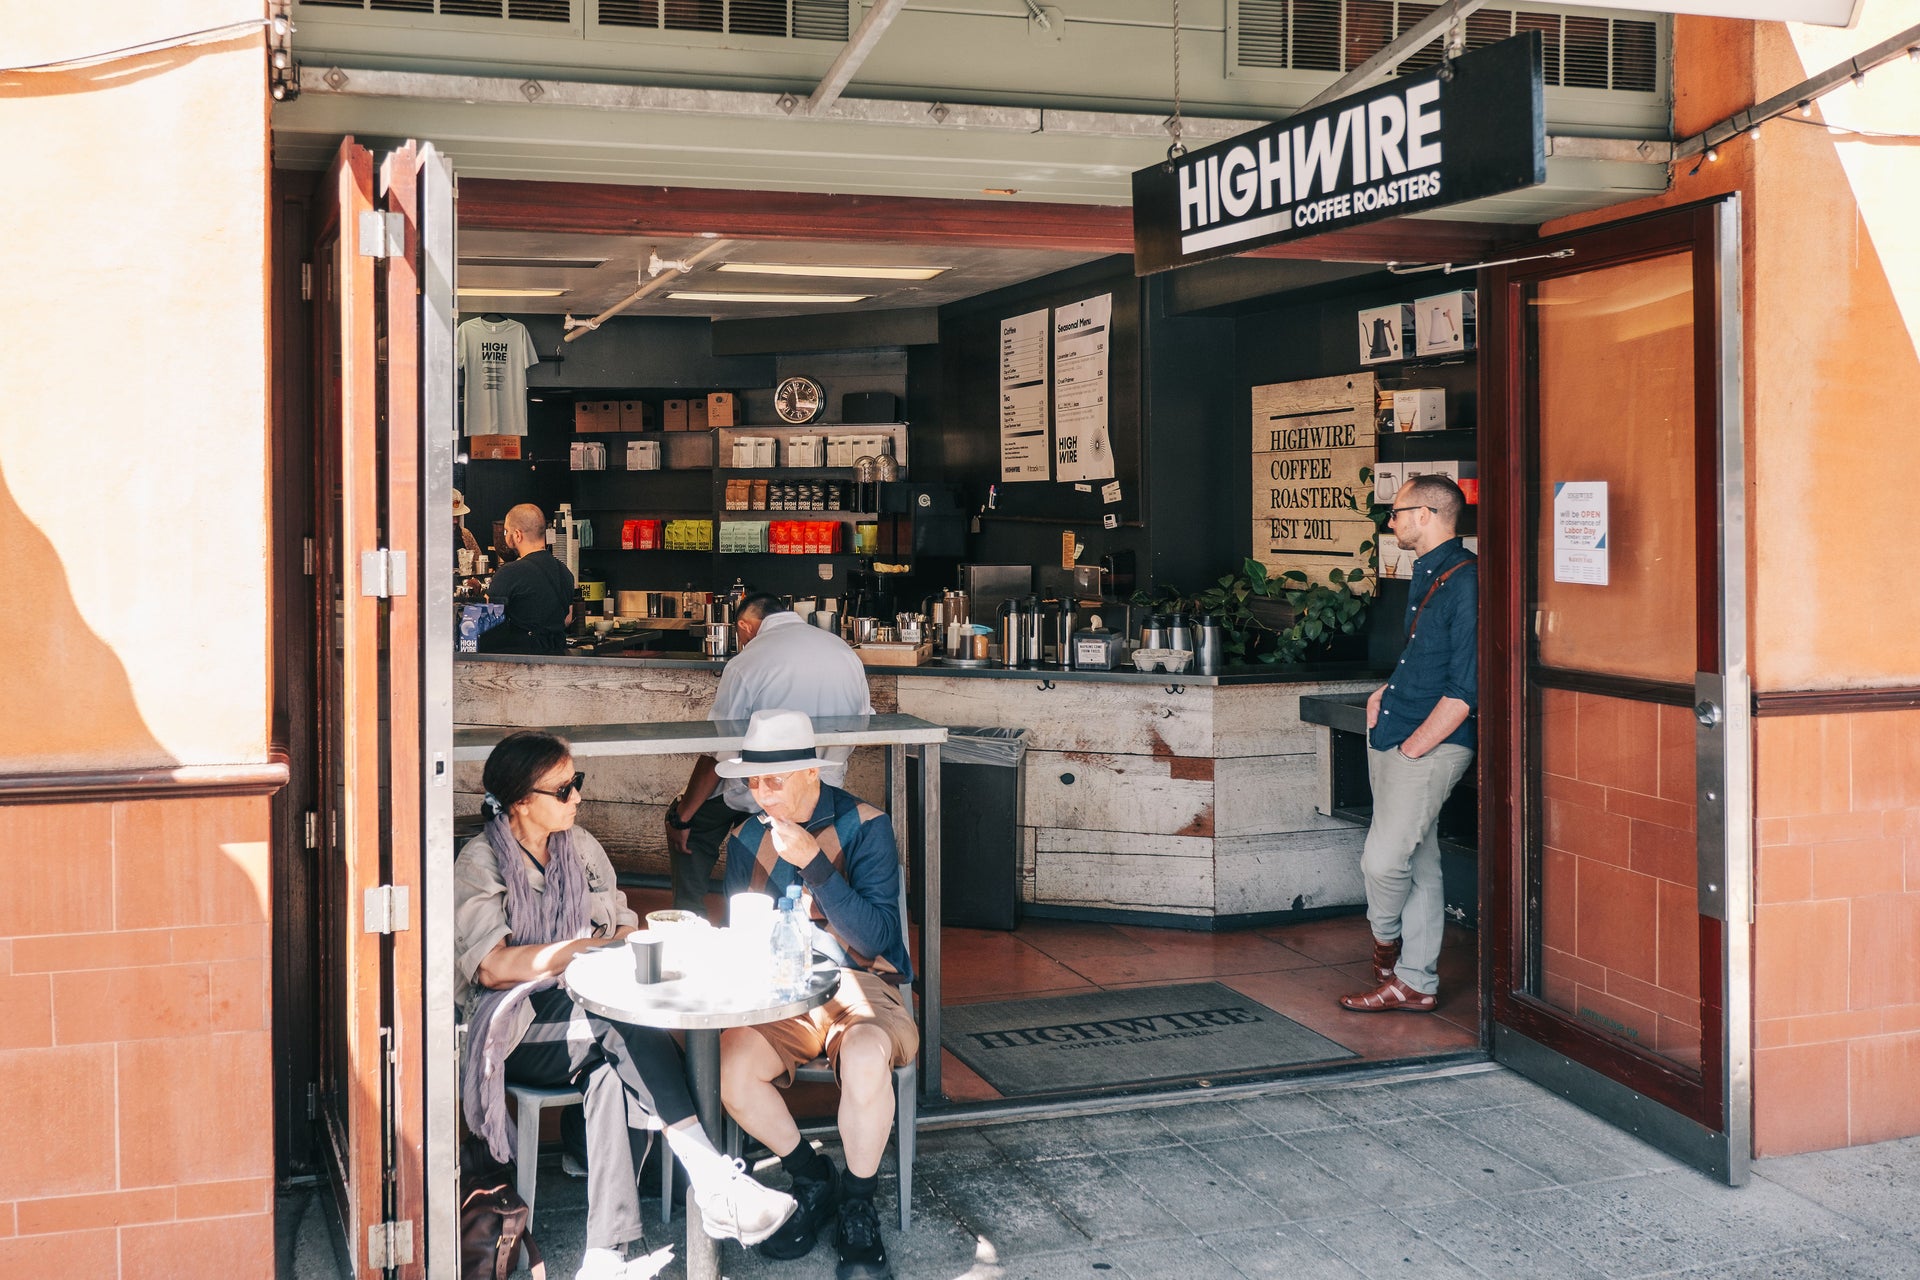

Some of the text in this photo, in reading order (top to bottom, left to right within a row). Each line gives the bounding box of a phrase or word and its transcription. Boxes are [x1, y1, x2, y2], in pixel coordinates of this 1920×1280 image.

[1179, 79, 1442, 231] HIGHWIRE
[1295, 170, 1441, 228] COFFEE ROASTERS
[1003, 327, 1017, 336] Coffee
[1057, 318, 1092, 333] Seasonal Menu
[481, 342, 508, 351] HIGH
[482, 352, 507, 361] WIRE
[1058, 436, 1078, 450] HIGH
[1270, 424, 1356, 451] HIGHWIRE
[1059, 450, 1078, 464] WIRE
[1270, 458, 1332, 480] COFFEE
[1270, 486, 1353, 509] ROASTERS
[1560, 510, 1601, 518] will be OPEN
[1271, 518, 1333, 540] EST 2011
[1583, 527, 1596, 536] Day
[966, 1007, 1263, 1051] HIGHWIRE
[1059, 1029, 1213, 1051] COFFEE ROASTERS
